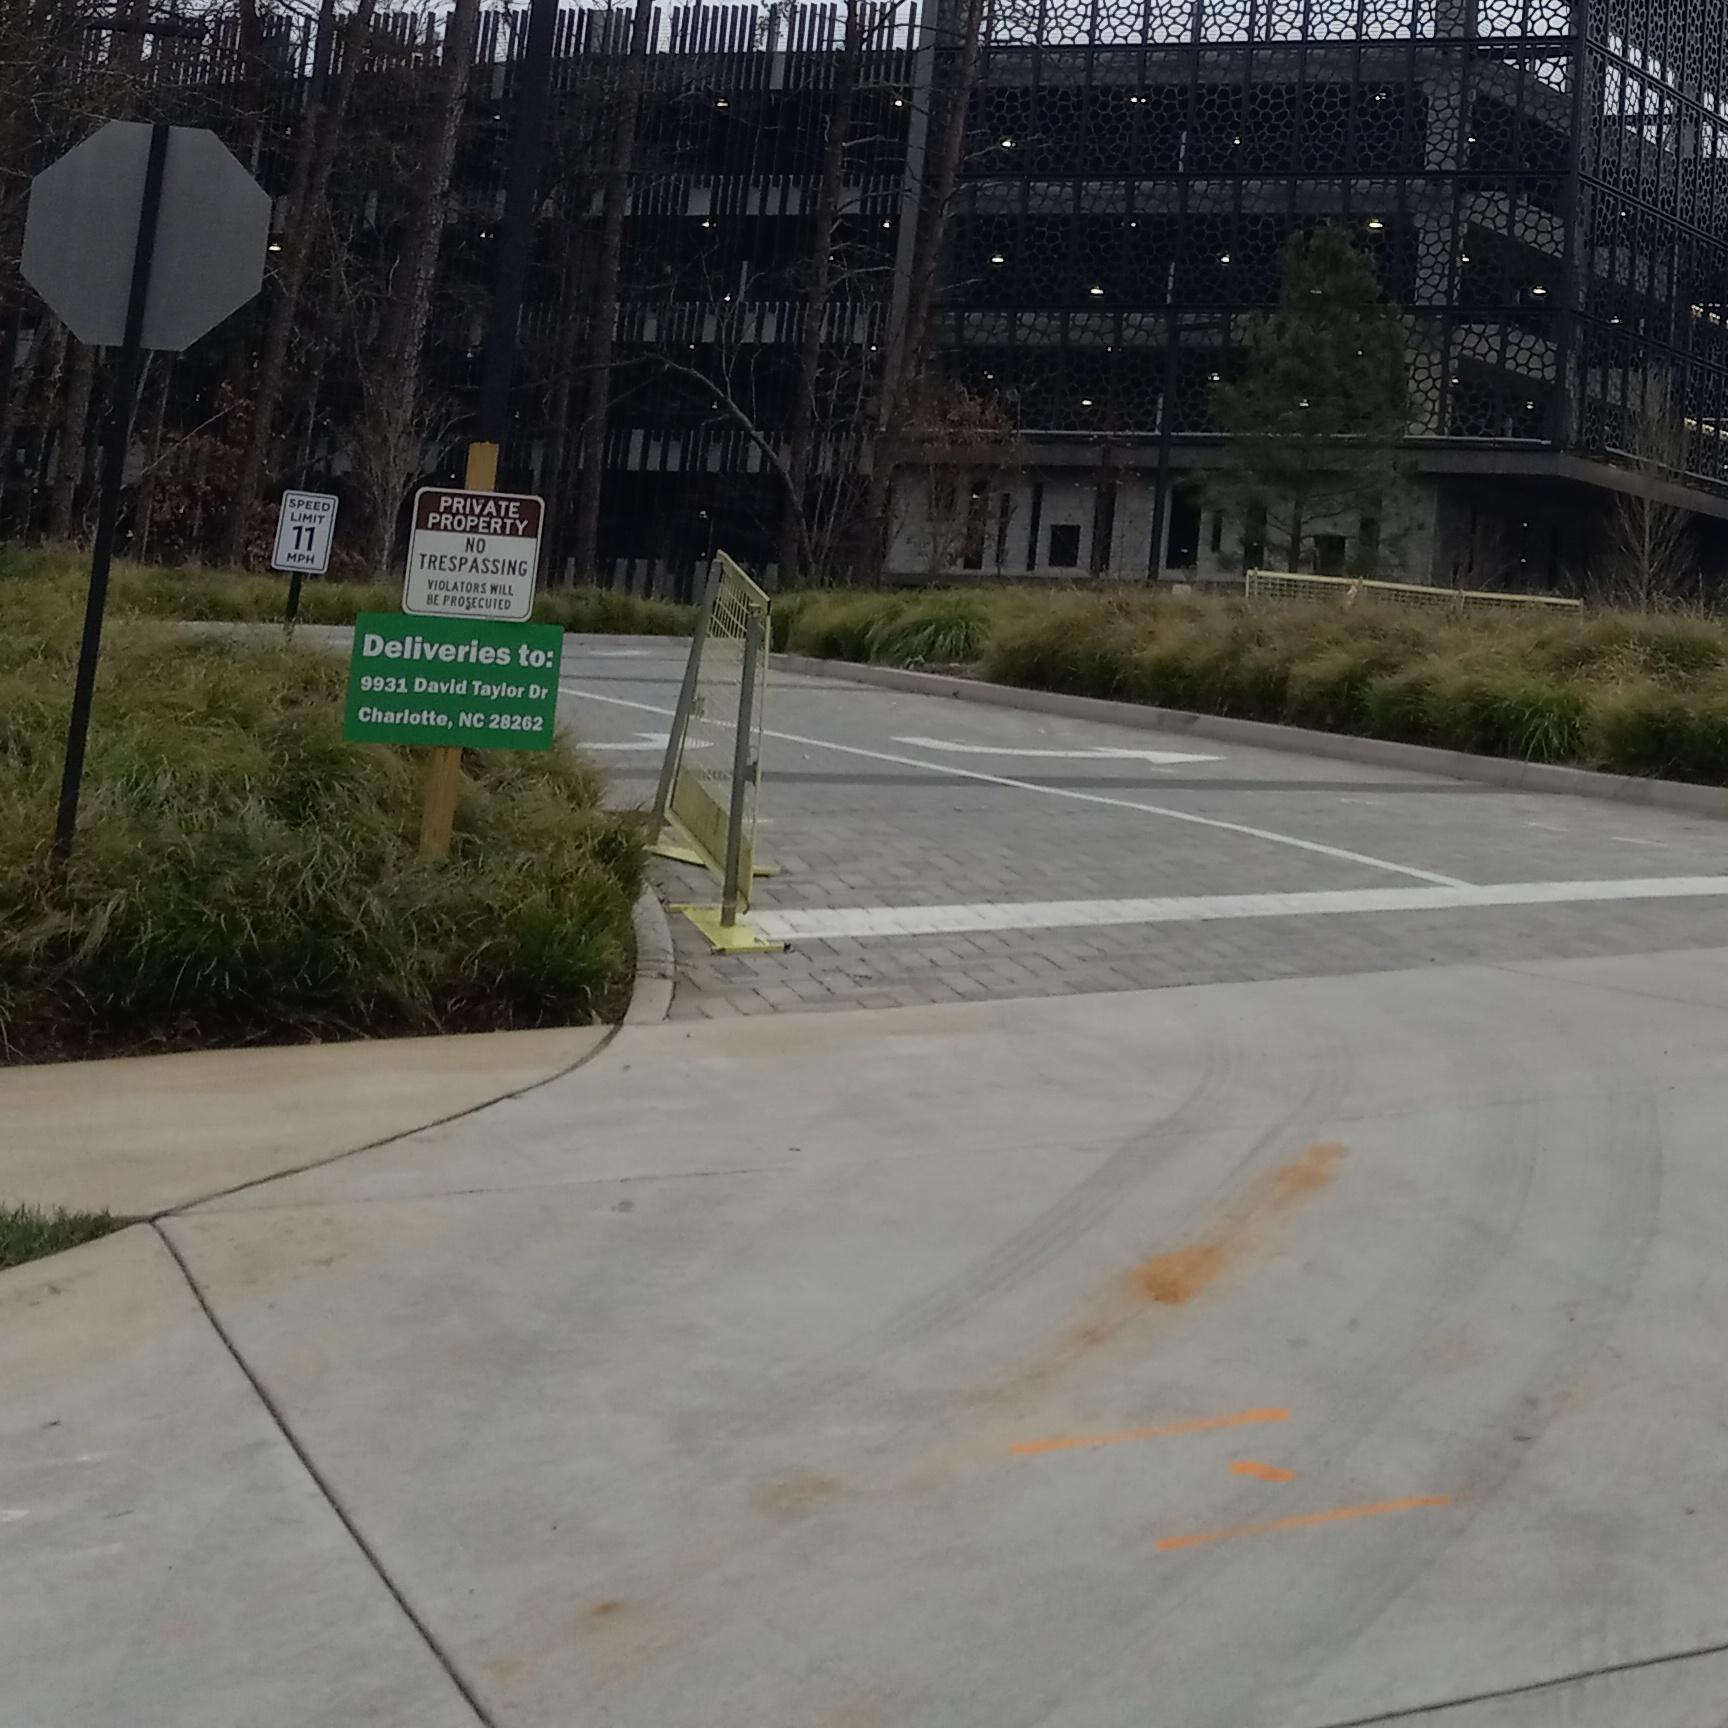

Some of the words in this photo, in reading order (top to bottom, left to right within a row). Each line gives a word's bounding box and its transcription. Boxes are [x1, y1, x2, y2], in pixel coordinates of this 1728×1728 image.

[288, 498, 331, 512] SPEED
[439, 496, 521, 518] PRIVATE
[290, 512, 325, 525] LIMIT
[427, 513, 529, 536] PROPERTY
[292, 526, 316, 552] 11
[465, 537, 486, 554] NO
[286, 553, 315, 565] MPH
[419, 553, 528, 577] TRESPASSING
[427, 579, 487, 595] VIOLATORS
[489, 583, 514, 597] WILL
[426, 594, 440, 606] BE
[443, 595, 511, 611] PROSECUTED
[362, 633, 511, 666] Deliveries
[518, 644, 554, 668] to:
[360, 675, 408, 694] 9931
[414, 677, 467, 696] David
[472, 680, 525, 700] Taylor
[528, 683, 548, 699] Dr
[358, 706, 454, 729] Charlotte,
[458, 712, 485, 728] NC
[488, 713, 544, 732] 28262
